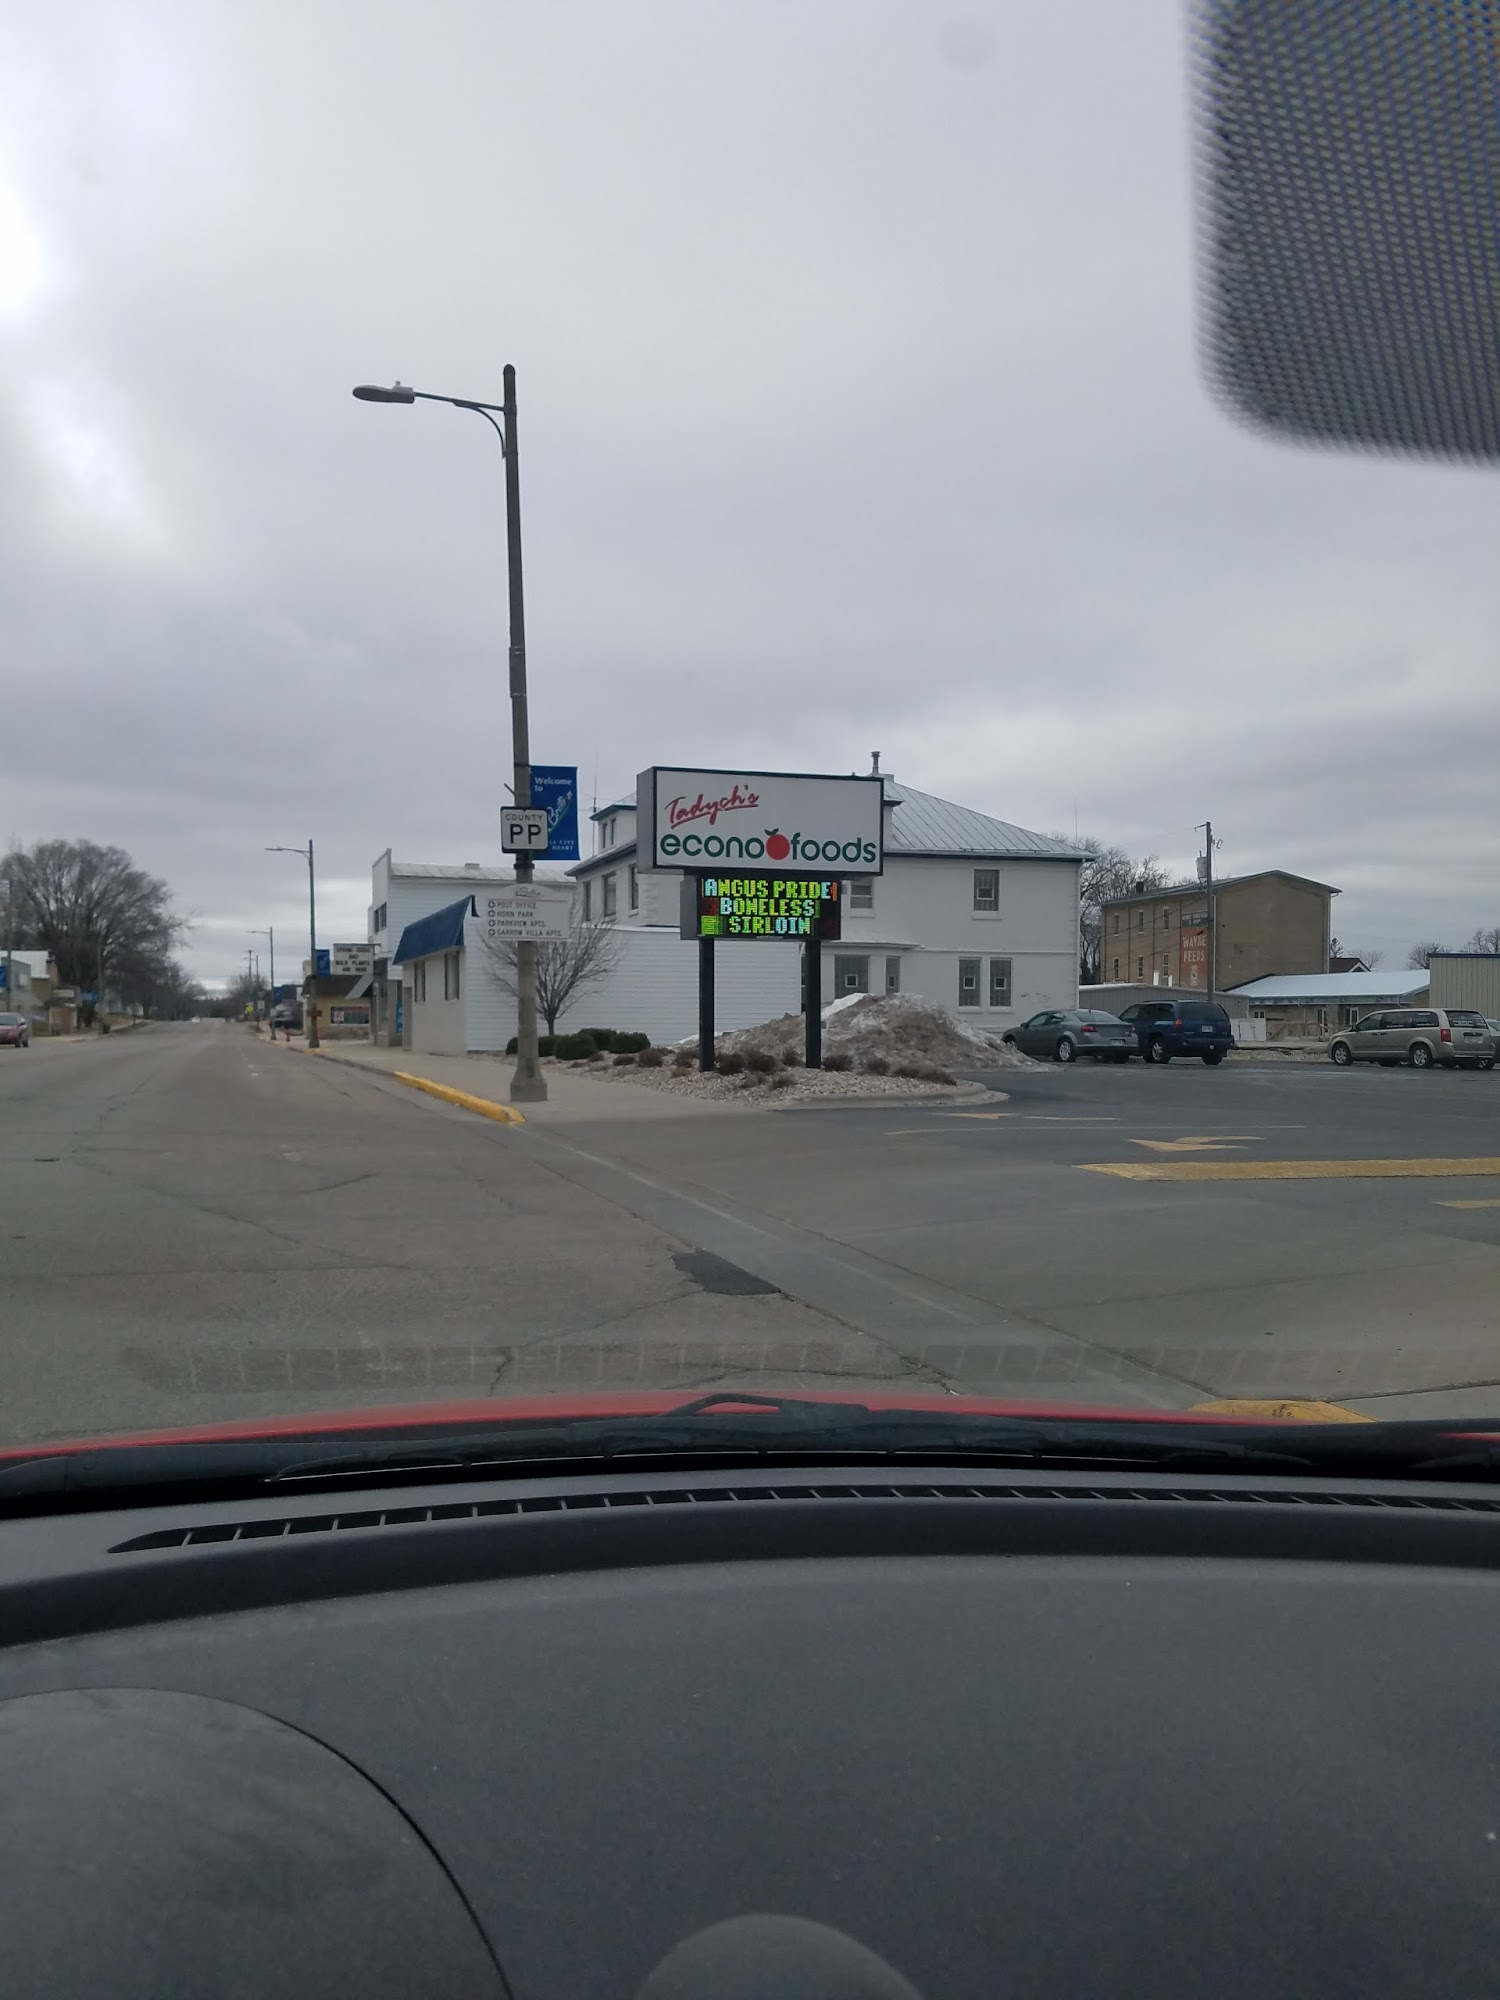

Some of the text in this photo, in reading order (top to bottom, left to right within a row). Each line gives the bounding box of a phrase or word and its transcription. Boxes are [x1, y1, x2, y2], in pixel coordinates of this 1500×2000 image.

[534, 777, 572, 785] Welcome
[664, 784, 759, 828] Tadych's
[505, 813, 543, 821] COUNTY
[510, 823, 542, 844] PP
[660, 832, 876, 863] econo foods
[704, 878, 831, 899] ANGUS PRIDE
[497, 901, 513, 909] POST
[720, 897, 815, 917] BONELESS
[728, 916, 811, 935] SIRLOIN
[1182, 934, 1206, 948] WAYNE
[1183, 950, 1205, 962] FEEDS
